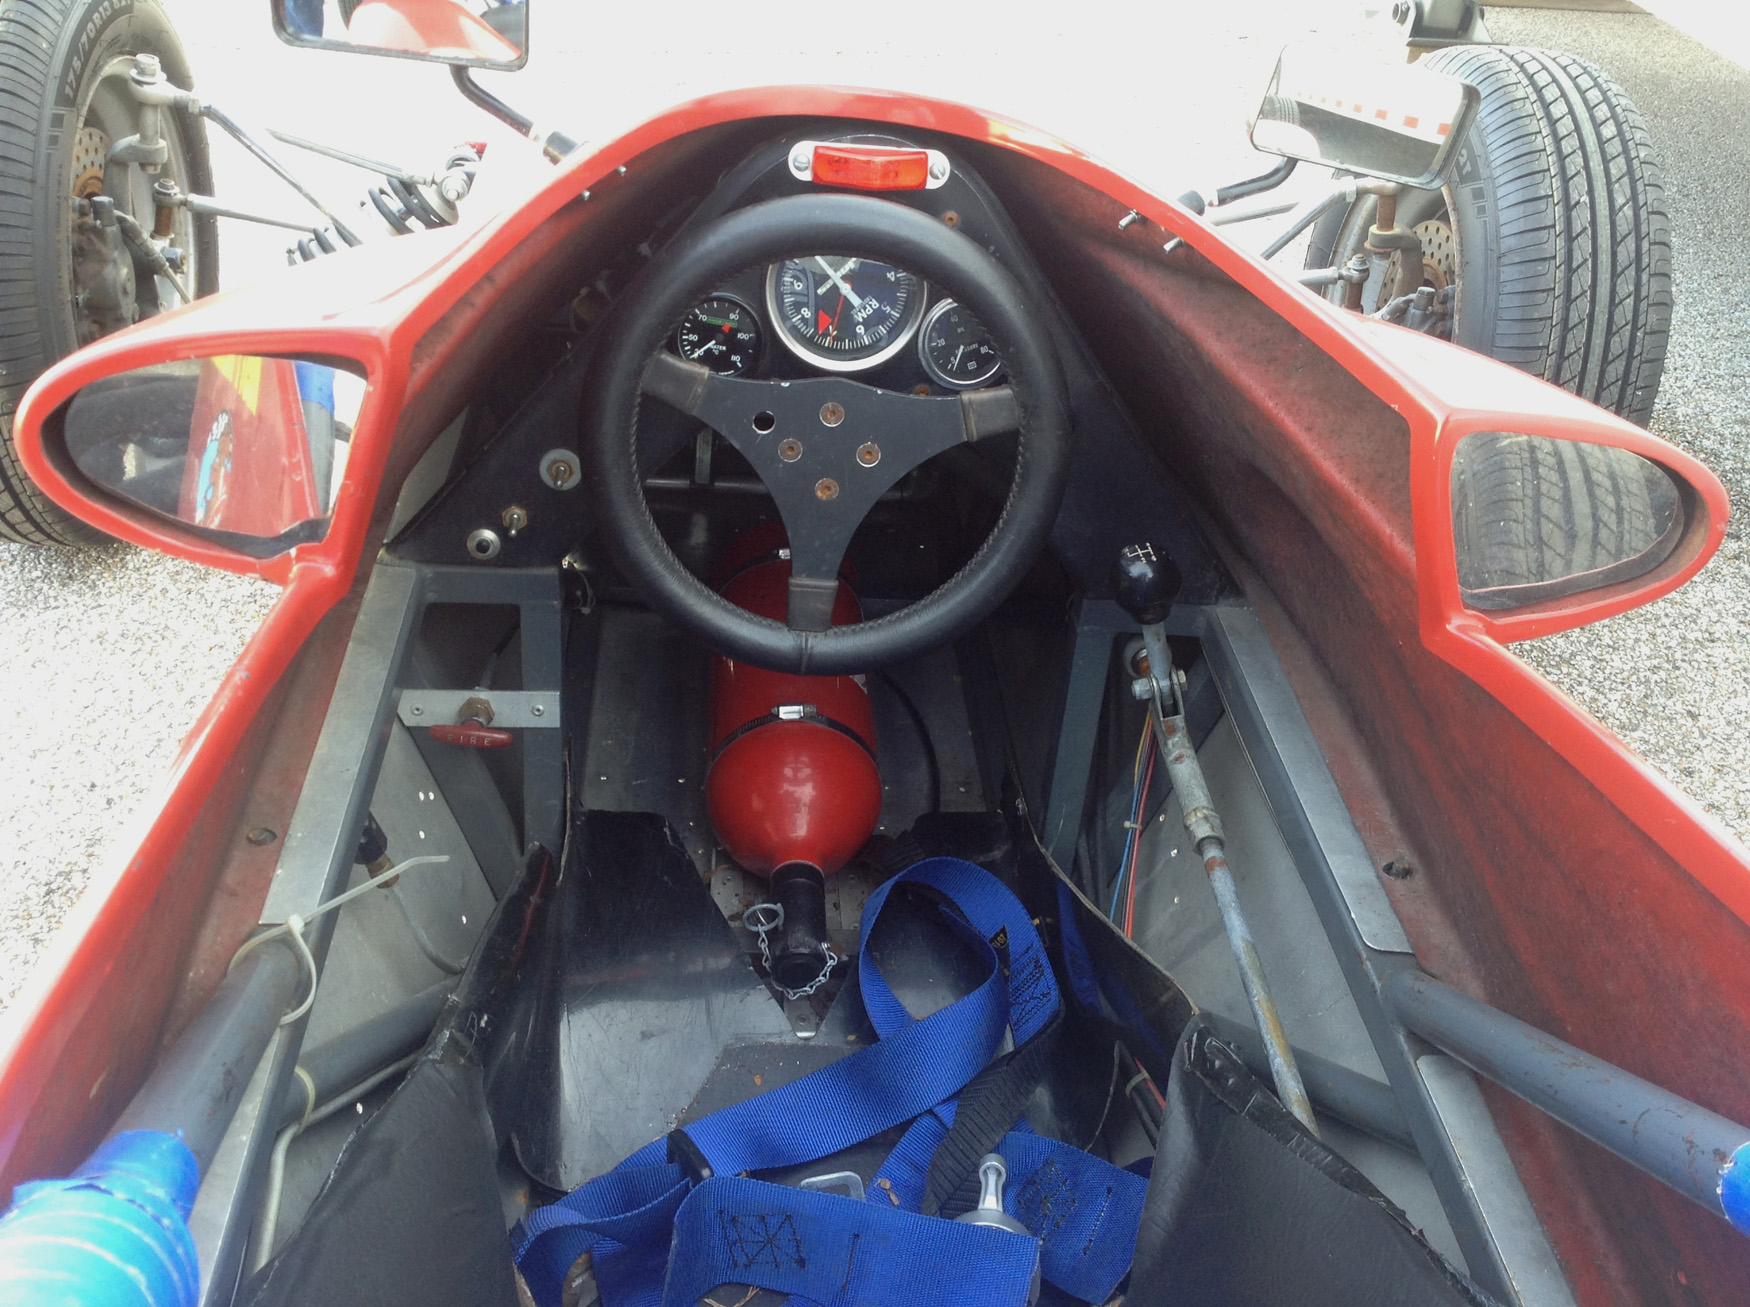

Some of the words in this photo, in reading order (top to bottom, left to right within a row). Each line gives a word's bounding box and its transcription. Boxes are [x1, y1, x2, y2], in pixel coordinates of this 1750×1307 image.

[886, 271, 896, 282] 4
[793, 280, 803, 290] 9
[854, 298, 880, 323] RPM
[881, 301, 892, 314] 5
[729, 313, 739, 321] 90
[800, 307, 811, 319] 8
[855, 325, 866, 335] 6
[688, 333, 698, 341] 50
[737, 332, 750, 340] 100
[937, 338, 946, 347] 20
[980, 345, 989, 354] 80
[447, 734, 492, 746] FIRE
